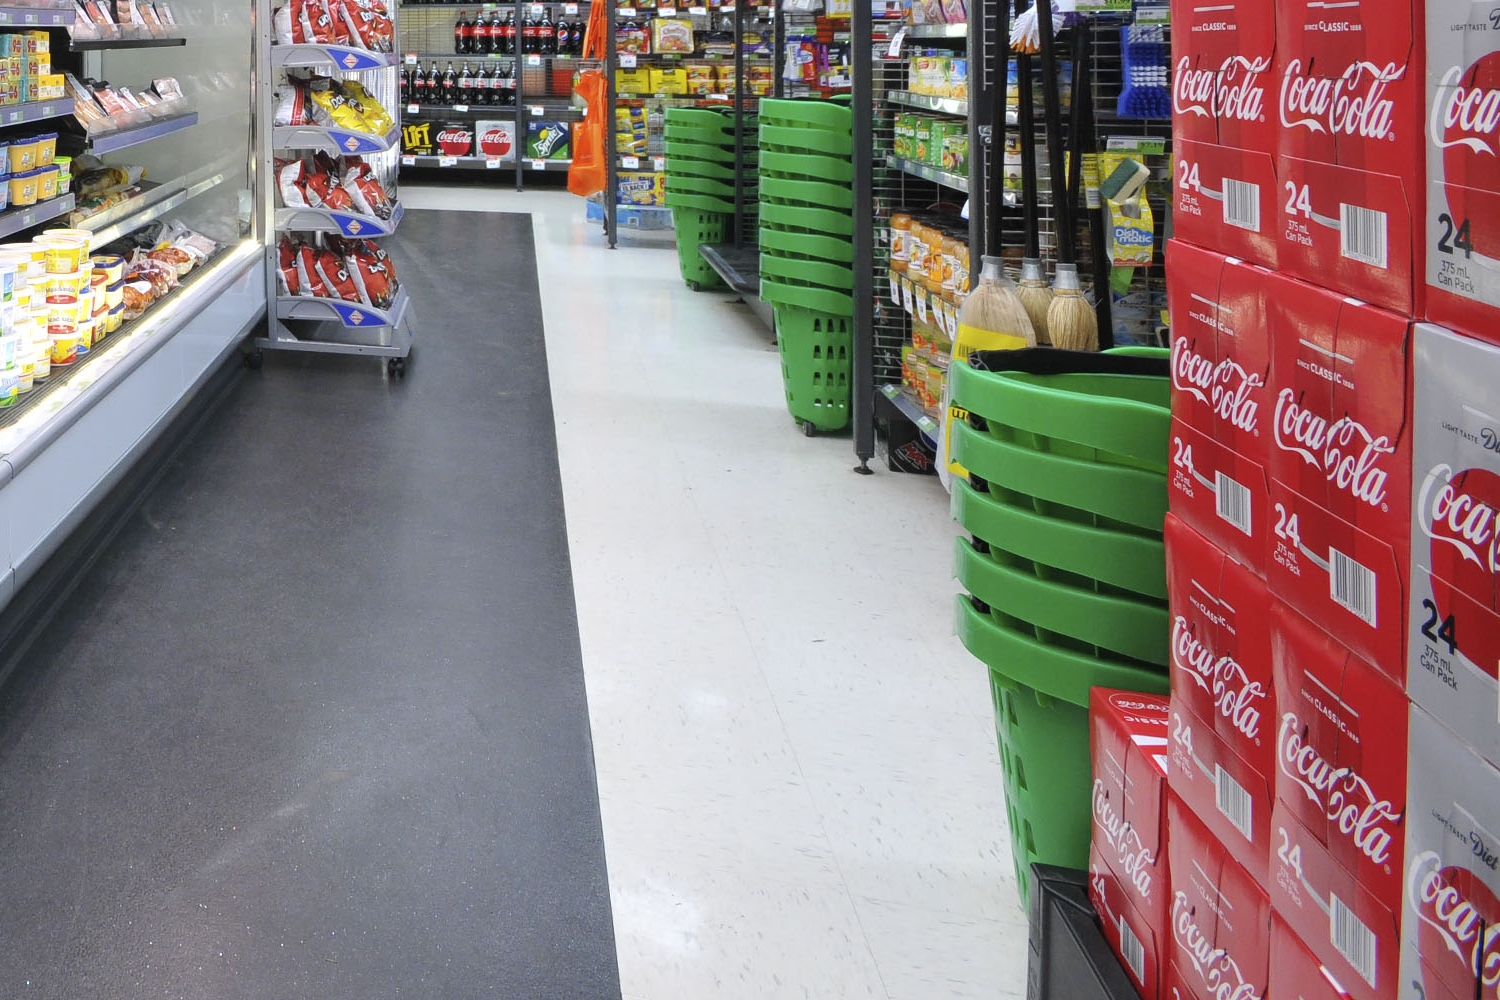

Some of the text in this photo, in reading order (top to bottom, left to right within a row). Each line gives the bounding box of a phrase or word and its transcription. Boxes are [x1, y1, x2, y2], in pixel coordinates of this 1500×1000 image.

[1449, 22, 1488, 32] LIGHT TASTE
[402, 122, 433, 151] LIFT
[537, 129, 559, 154] Sprite
[1179, 159, 1200, 192] 24
[1285, 180, 1312, 219] 24
[1114, 227, 1139, 239] Dish
[1118, 232, 1152, 246] matic
[1437, 212, 1475, 260] 24
[1437, 271, 1476, 295] Can Pack
[1441, 259, 1471, 280] 375 mL
[1309, 362, 1343, 385] CLASSIC
[1442, 421, 1478, 445] LIGHT TASTE
[1173, 436, 1194, 474] 24
[1274, 502, 1300, 548] 24
[1421, 598, 1458, 656] 24
[1172, 712, 1193, 755] 24
[1278, 827, 1303, 878] 24
[1469, 831, 1499, 872] Diet
